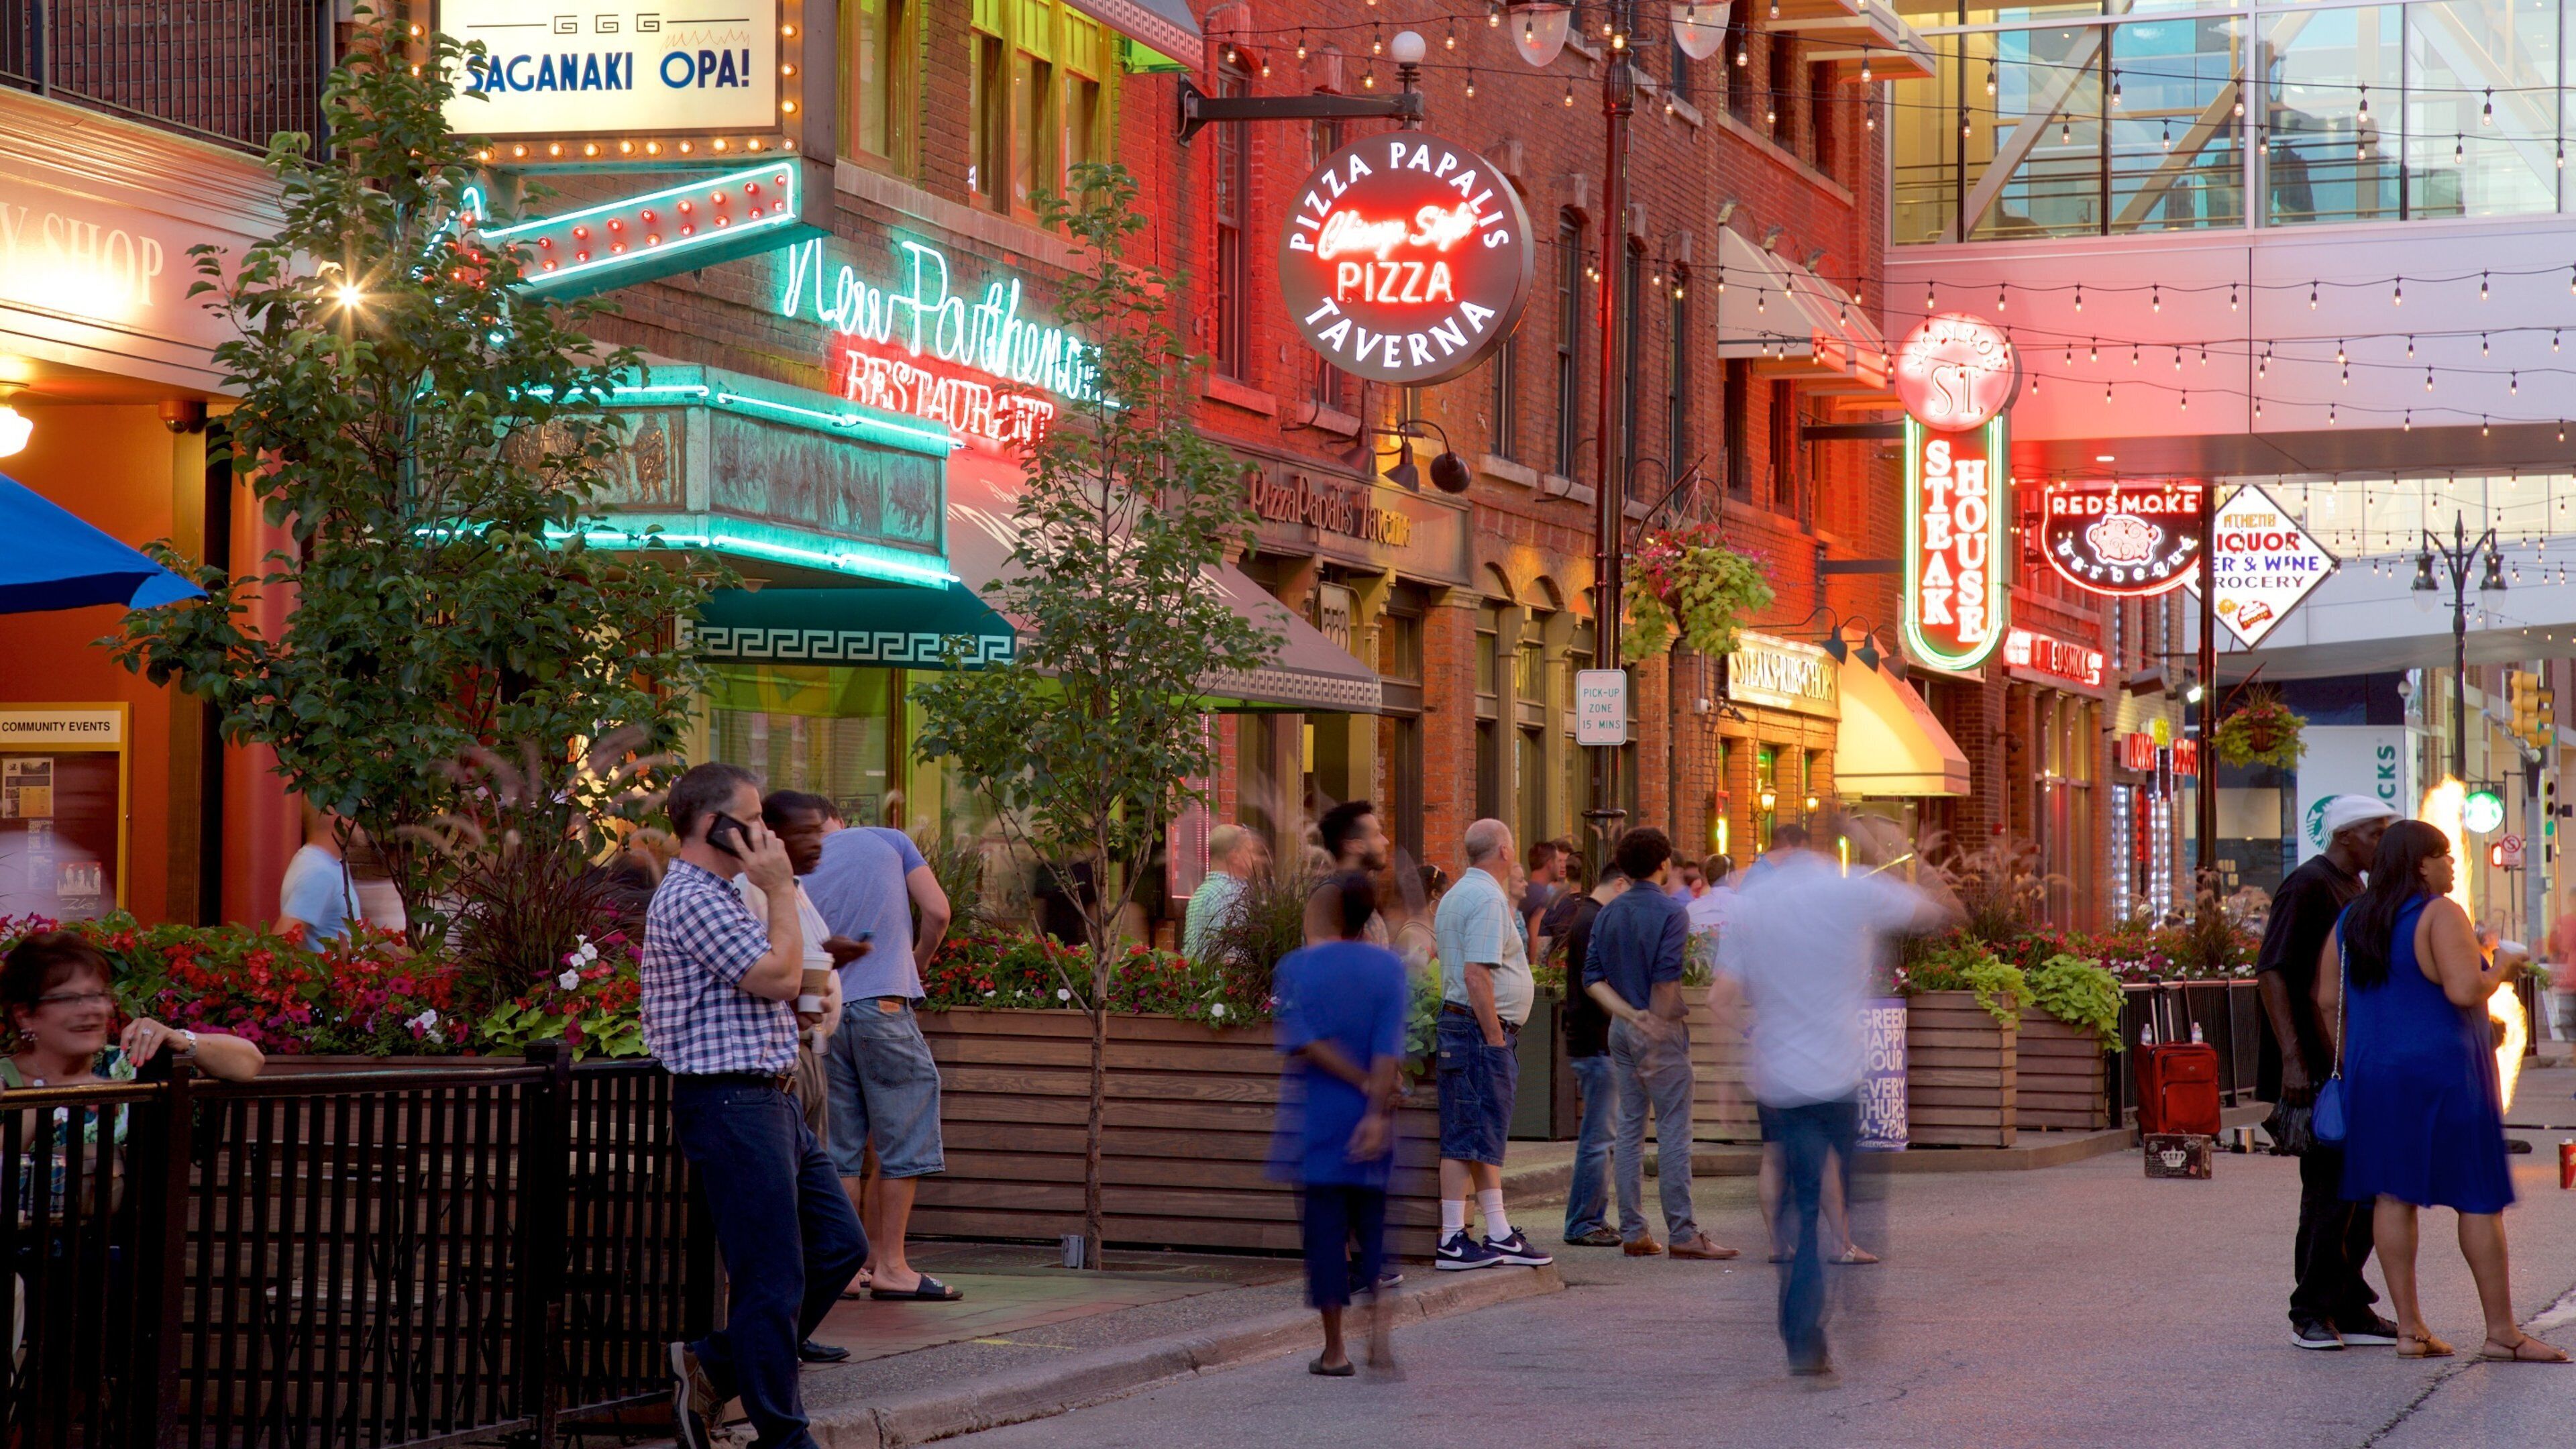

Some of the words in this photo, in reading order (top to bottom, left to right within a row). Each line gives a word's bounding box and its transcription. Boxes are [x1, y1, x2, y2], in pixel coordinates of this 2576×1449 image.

[466, 52, 633, 93] SAGANAKI
[659, 49, 749, 89] OPA!
[1289, 153, 1373, 253] PIZZA
[1390, 142, 1509, 249] PAPALIS
[43, 212, 164, 307] SHOP
[784, 237, 895, 345] New
[1336, 262, 1456, 304] PIZZA
[1304, 297, 1496, 368] TAVERNA
[1905, 323, 2002, 373] MONROE
[1922, 439, 1953, 625] STEAK
[1954, 460, 1988, 643] HOUSE
[2216, 532, 2301, 554] IQUOR
[2243, 557, 2257, 572] &
[2264, 555, 2319, 572] WINE
[1583, 688, 1620, 698] PICK-UP
[1589, 703, 1613, 713] ZONE
[2, 722, 66, 732] COMMUNITY
[69, 721, 111, 732] EVENTS
[1583, 720, 1592, 730] 15
[1599, 720, 1621, 730] MINS
[1856, 1008, 1908, 1029] GREEK
[1856, 1077, 1906, 1099] EVERY
[1858, 1097, 1906, 1120] THURS
